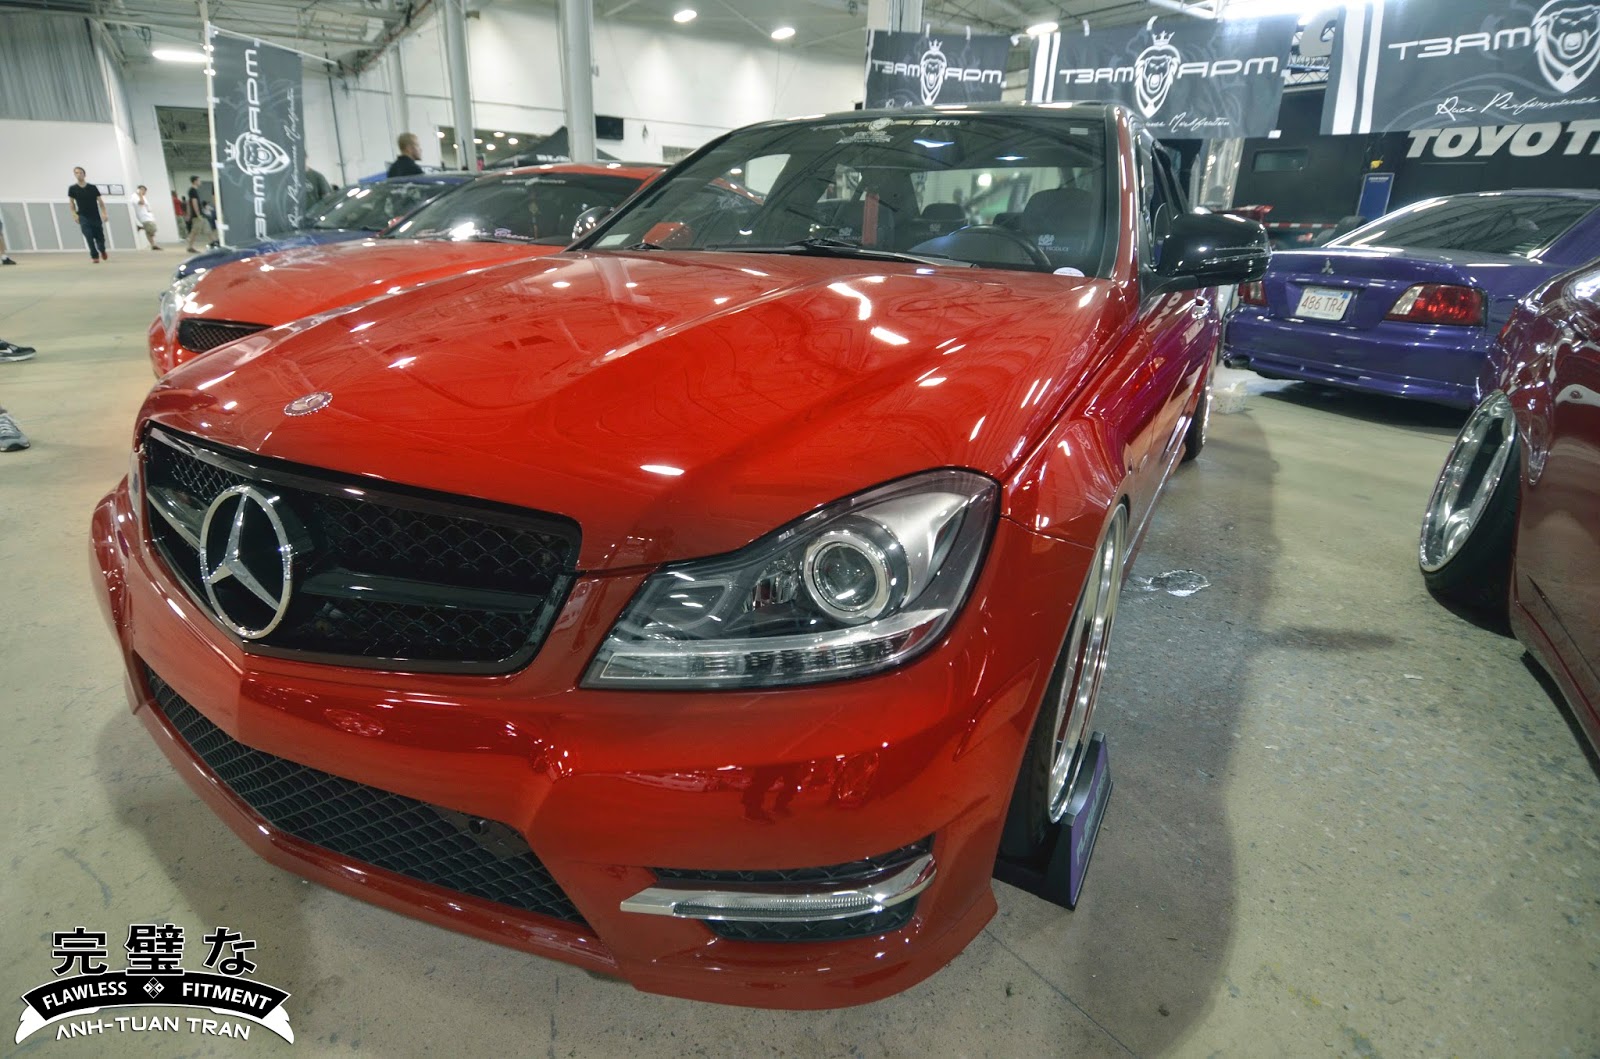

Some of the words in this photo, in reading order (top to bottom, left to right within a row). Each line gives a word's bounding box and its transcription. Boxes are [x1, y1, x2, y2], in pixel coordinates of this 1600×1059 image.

[1435, 95, 1476, 121] Race
[1406, 119, 1600, 158] TOYOT
[1324, 296, 1346, 313] TR4
